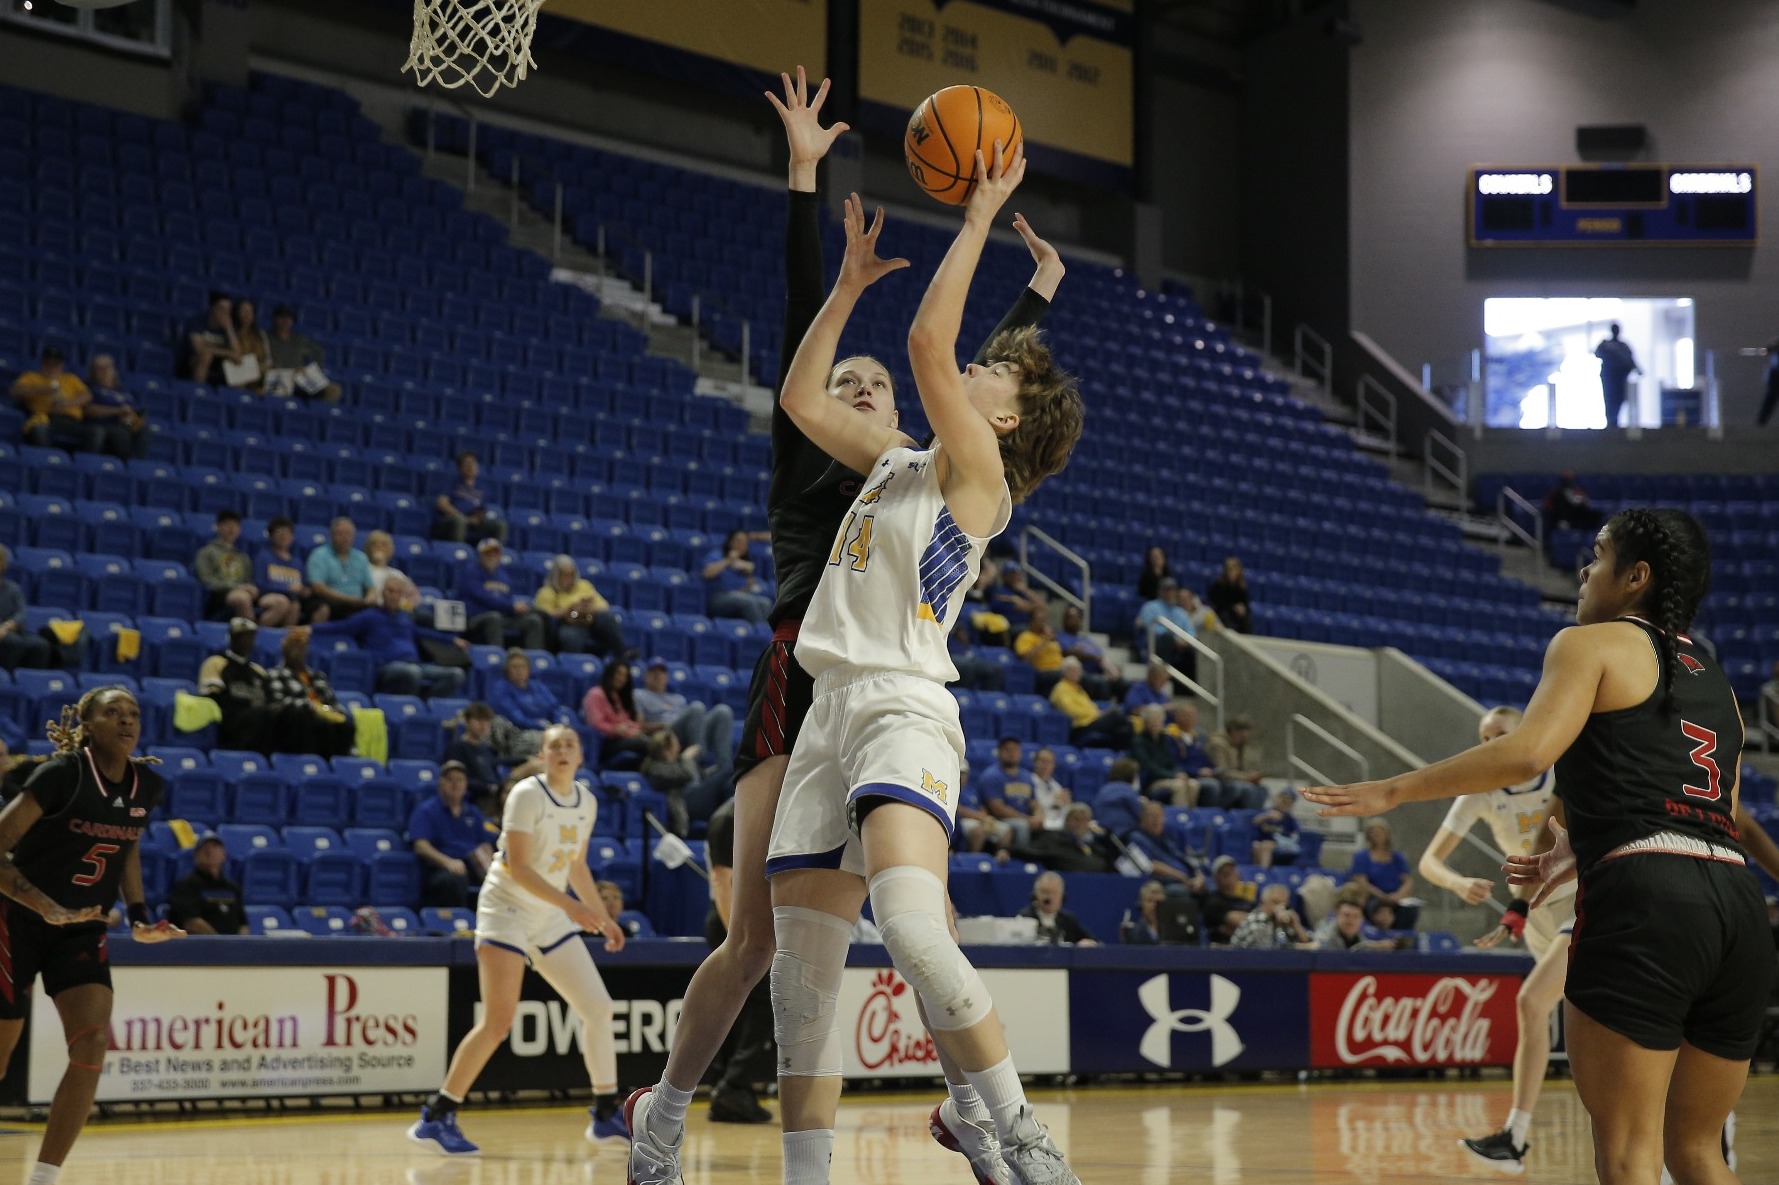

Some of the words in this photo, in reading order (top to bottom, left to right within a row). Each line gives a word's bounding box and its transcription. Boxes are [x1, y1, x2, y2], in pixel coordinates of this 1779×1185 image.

[829, 511, 874, 572] 14
[1681, 719, 1721, 800] 3
[921, 768, 948, 804] M
[559, 824, 578, 844] M
[71, 843, 120, 886] 5
[322, 973, 419, 1047] Press
[1335, 975, 1498, 1064] Coca-Cola
[119, 1056, 160, 1074] Best
[166, 1055, 214, 1073] News
[219, 1054, 251, 1071] and
[257, 1053, 353, 1073] Advertising
[358, 1052, 415, 1069] Source
